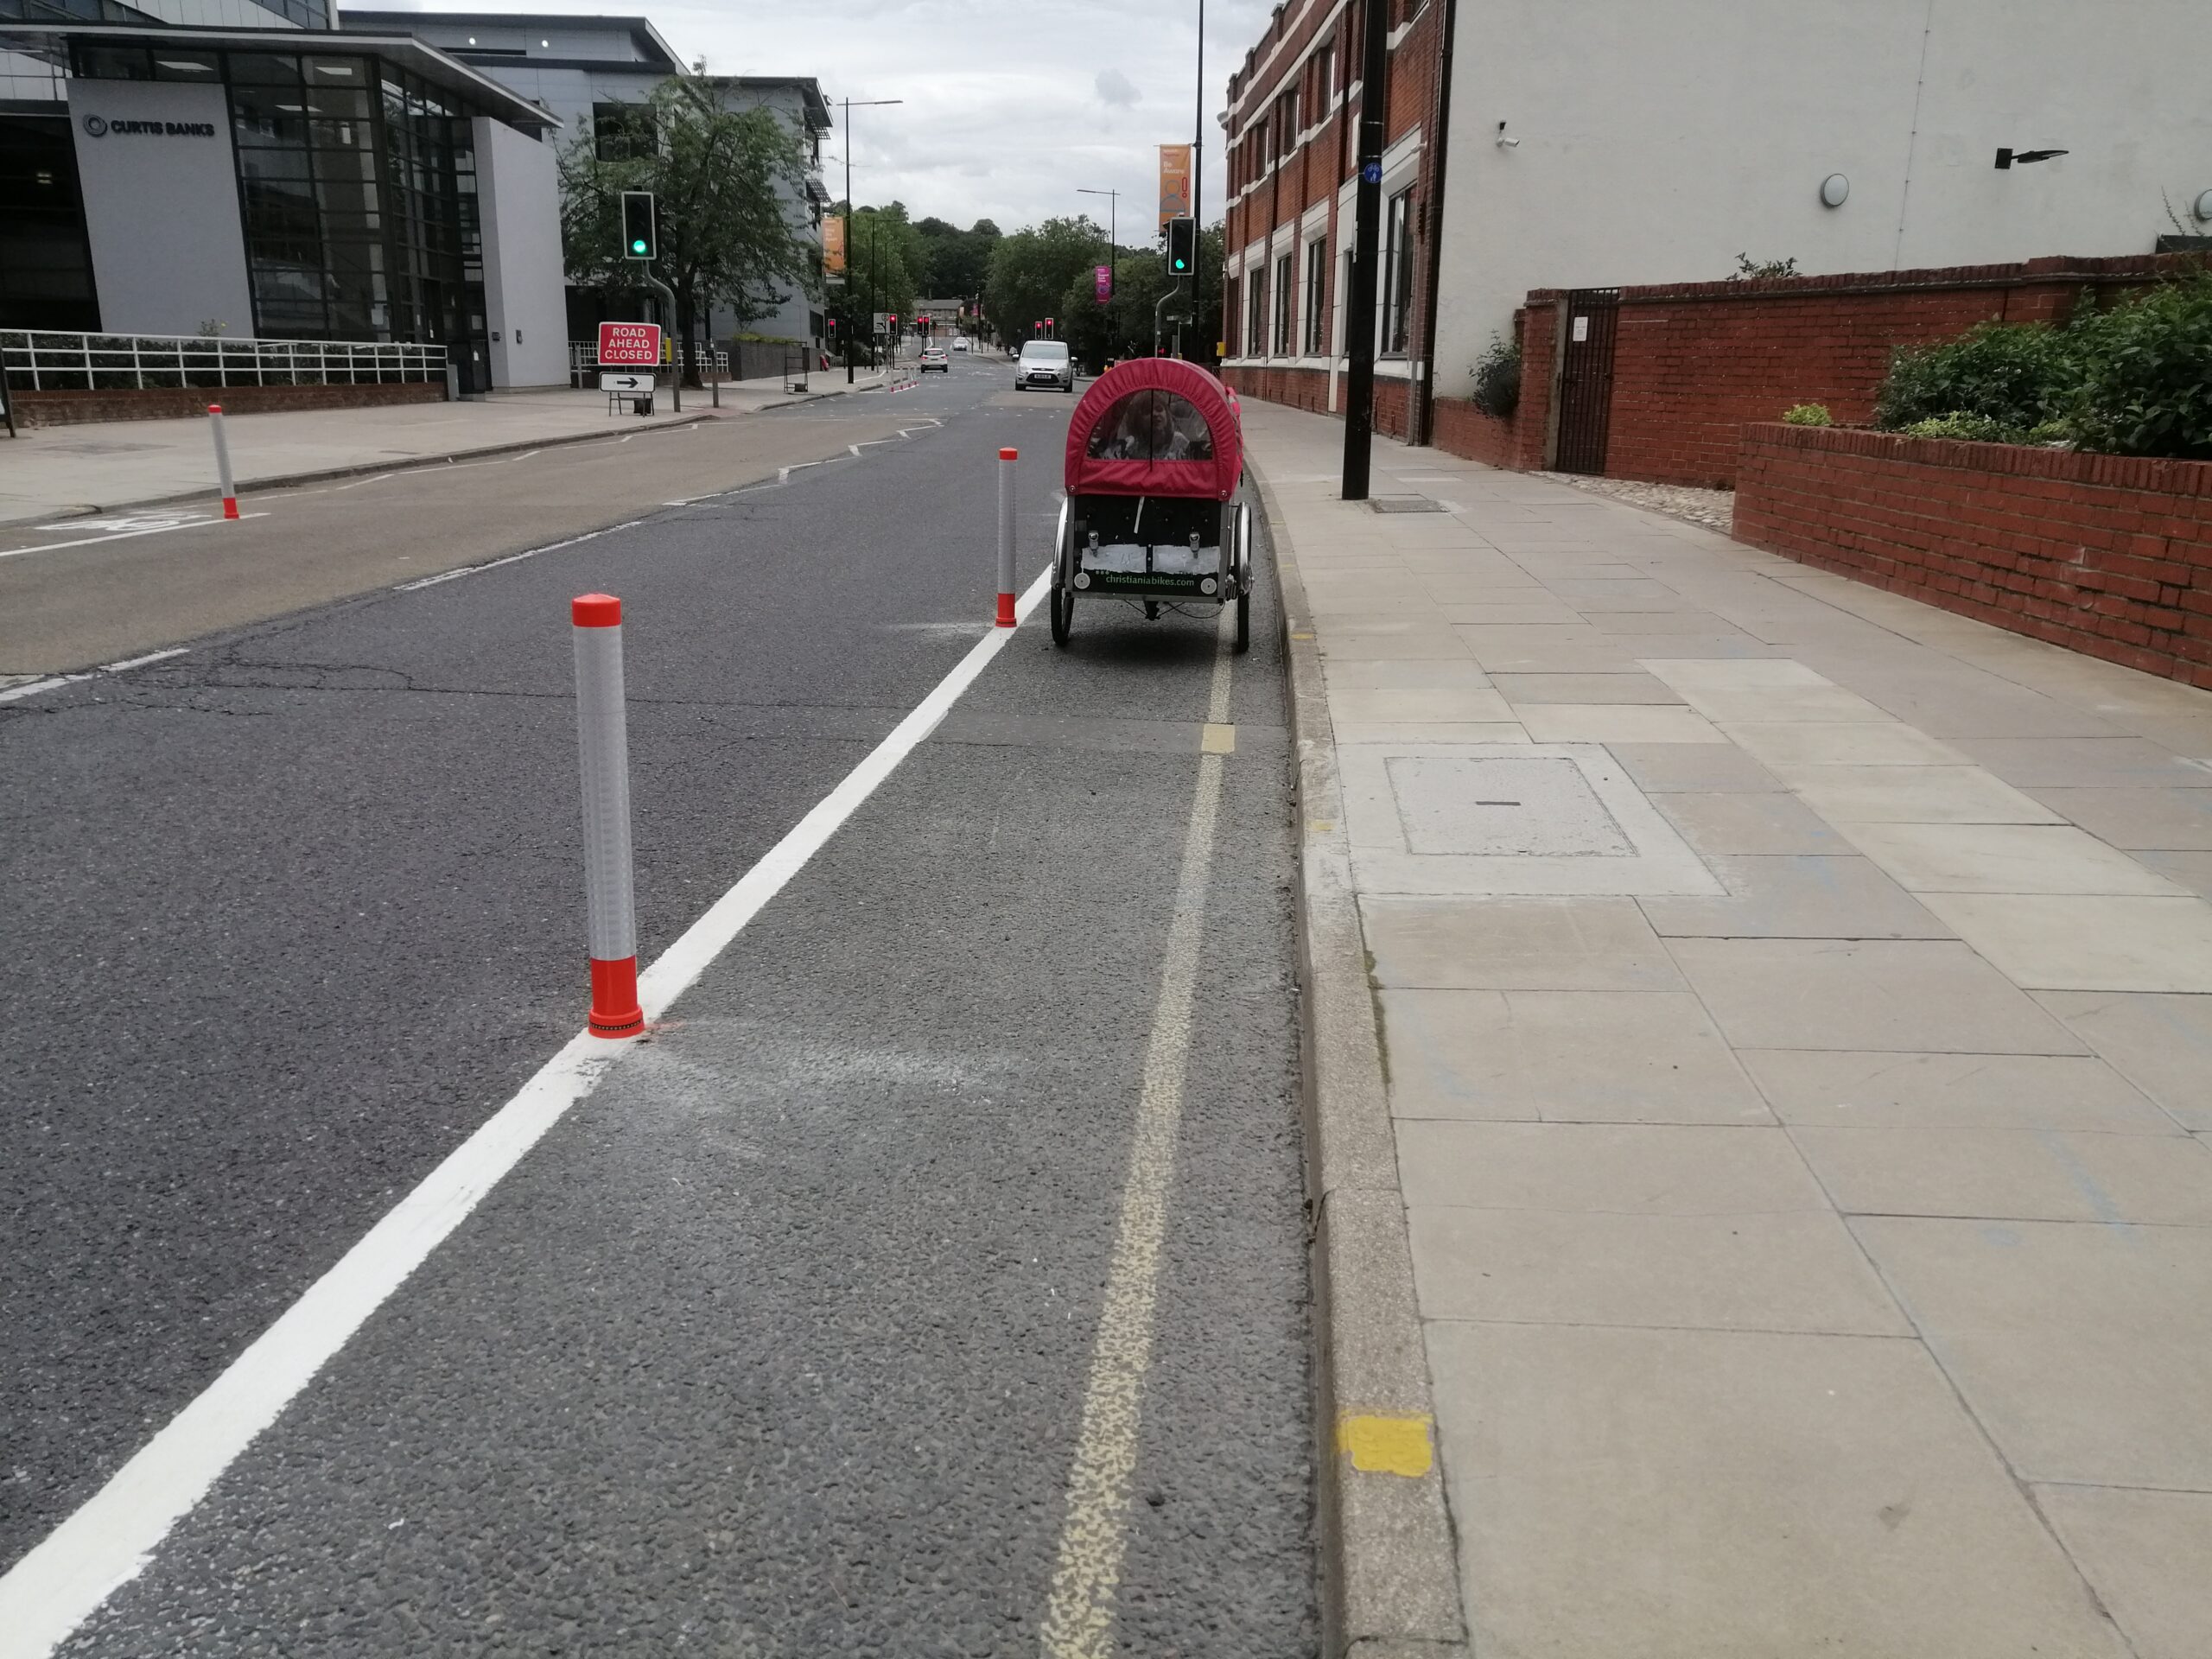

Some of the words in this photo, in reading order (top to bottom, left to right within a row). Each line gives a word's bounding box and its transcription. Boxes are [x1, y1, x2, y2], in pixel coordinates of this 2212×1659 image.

[111, 120, 163, 135] CURTIS
[165, 122, 215, 137] BANKS
[613, 327, 646, 338] ROAD
[608, 338, 650, 348] AHEAD
[605, 349, 652, 360] CLOSED
[1105, 574, 1195, 587] christianiabikes.com
